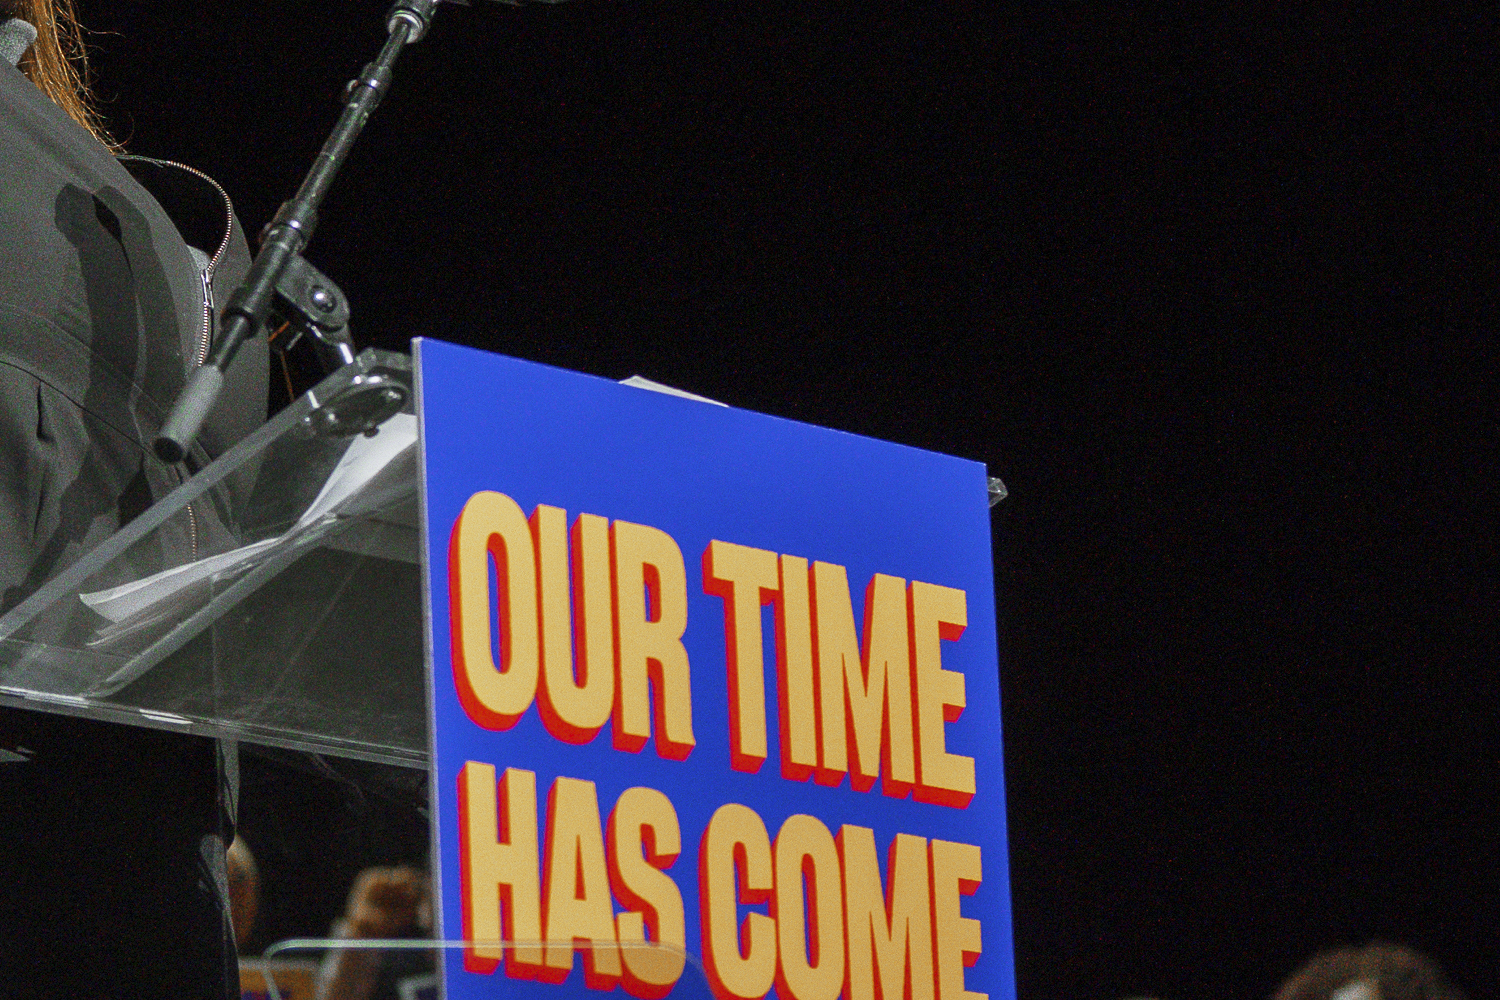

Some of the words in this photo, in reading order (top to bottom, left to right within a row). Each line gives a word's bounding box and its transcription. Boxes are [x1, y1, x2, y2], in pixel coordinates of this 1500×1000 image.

[449, 490, 696, 762] OUR
[703, 539, 977, 810] TIME
[457, 760, 687, 1000] HAS
[699, 803, 990, 1000] COME
